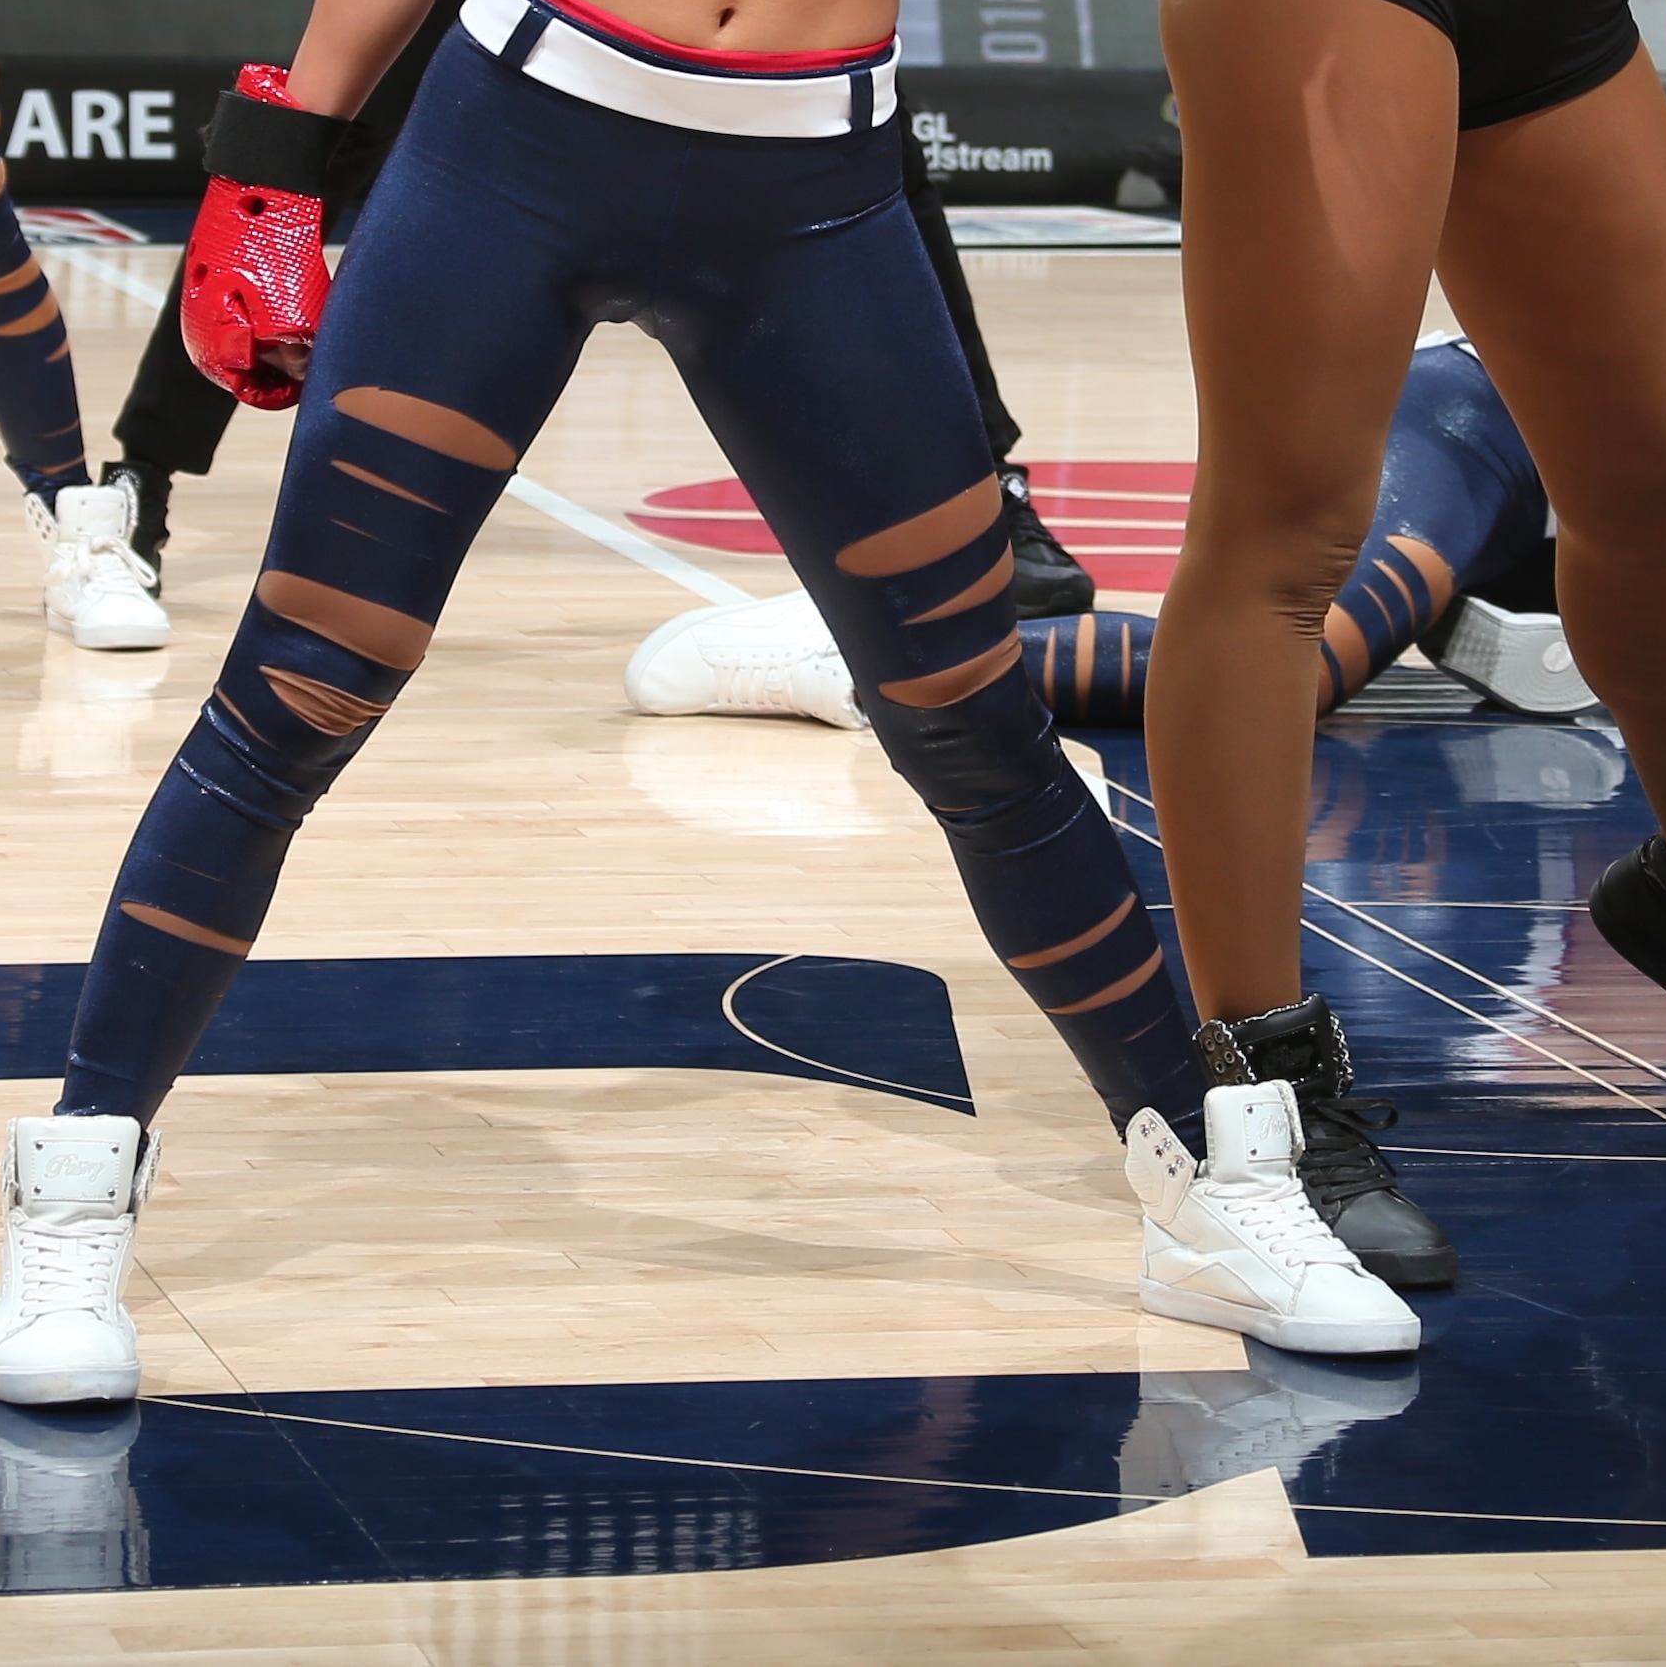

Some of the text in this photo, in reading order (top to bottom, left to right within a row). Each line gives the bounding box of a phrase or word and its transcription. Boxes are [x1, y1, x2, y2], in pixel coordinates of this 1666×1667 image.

[5, 89, 176, 160] ARE
[911, 112, 957, 142] GL
[923, 141, 1053, 172] dstream
